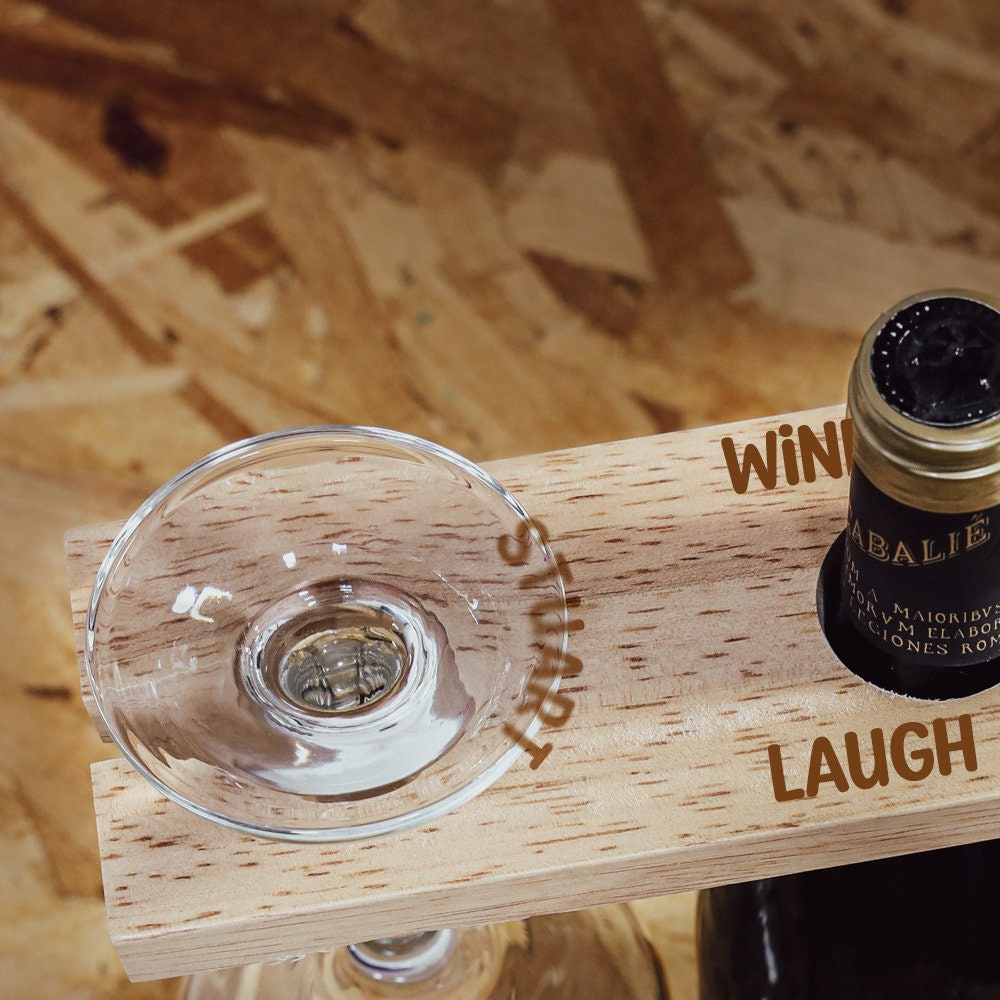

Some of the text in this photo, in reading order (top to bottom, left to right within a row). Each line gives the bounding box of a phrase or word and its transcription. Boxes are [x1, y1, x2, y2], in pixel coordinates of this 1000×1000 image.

[849, 513, 991, 567] ABALIÉ
[498, 518, 586, 771] STUART
[768, 713, 978, 802] LAUGH
